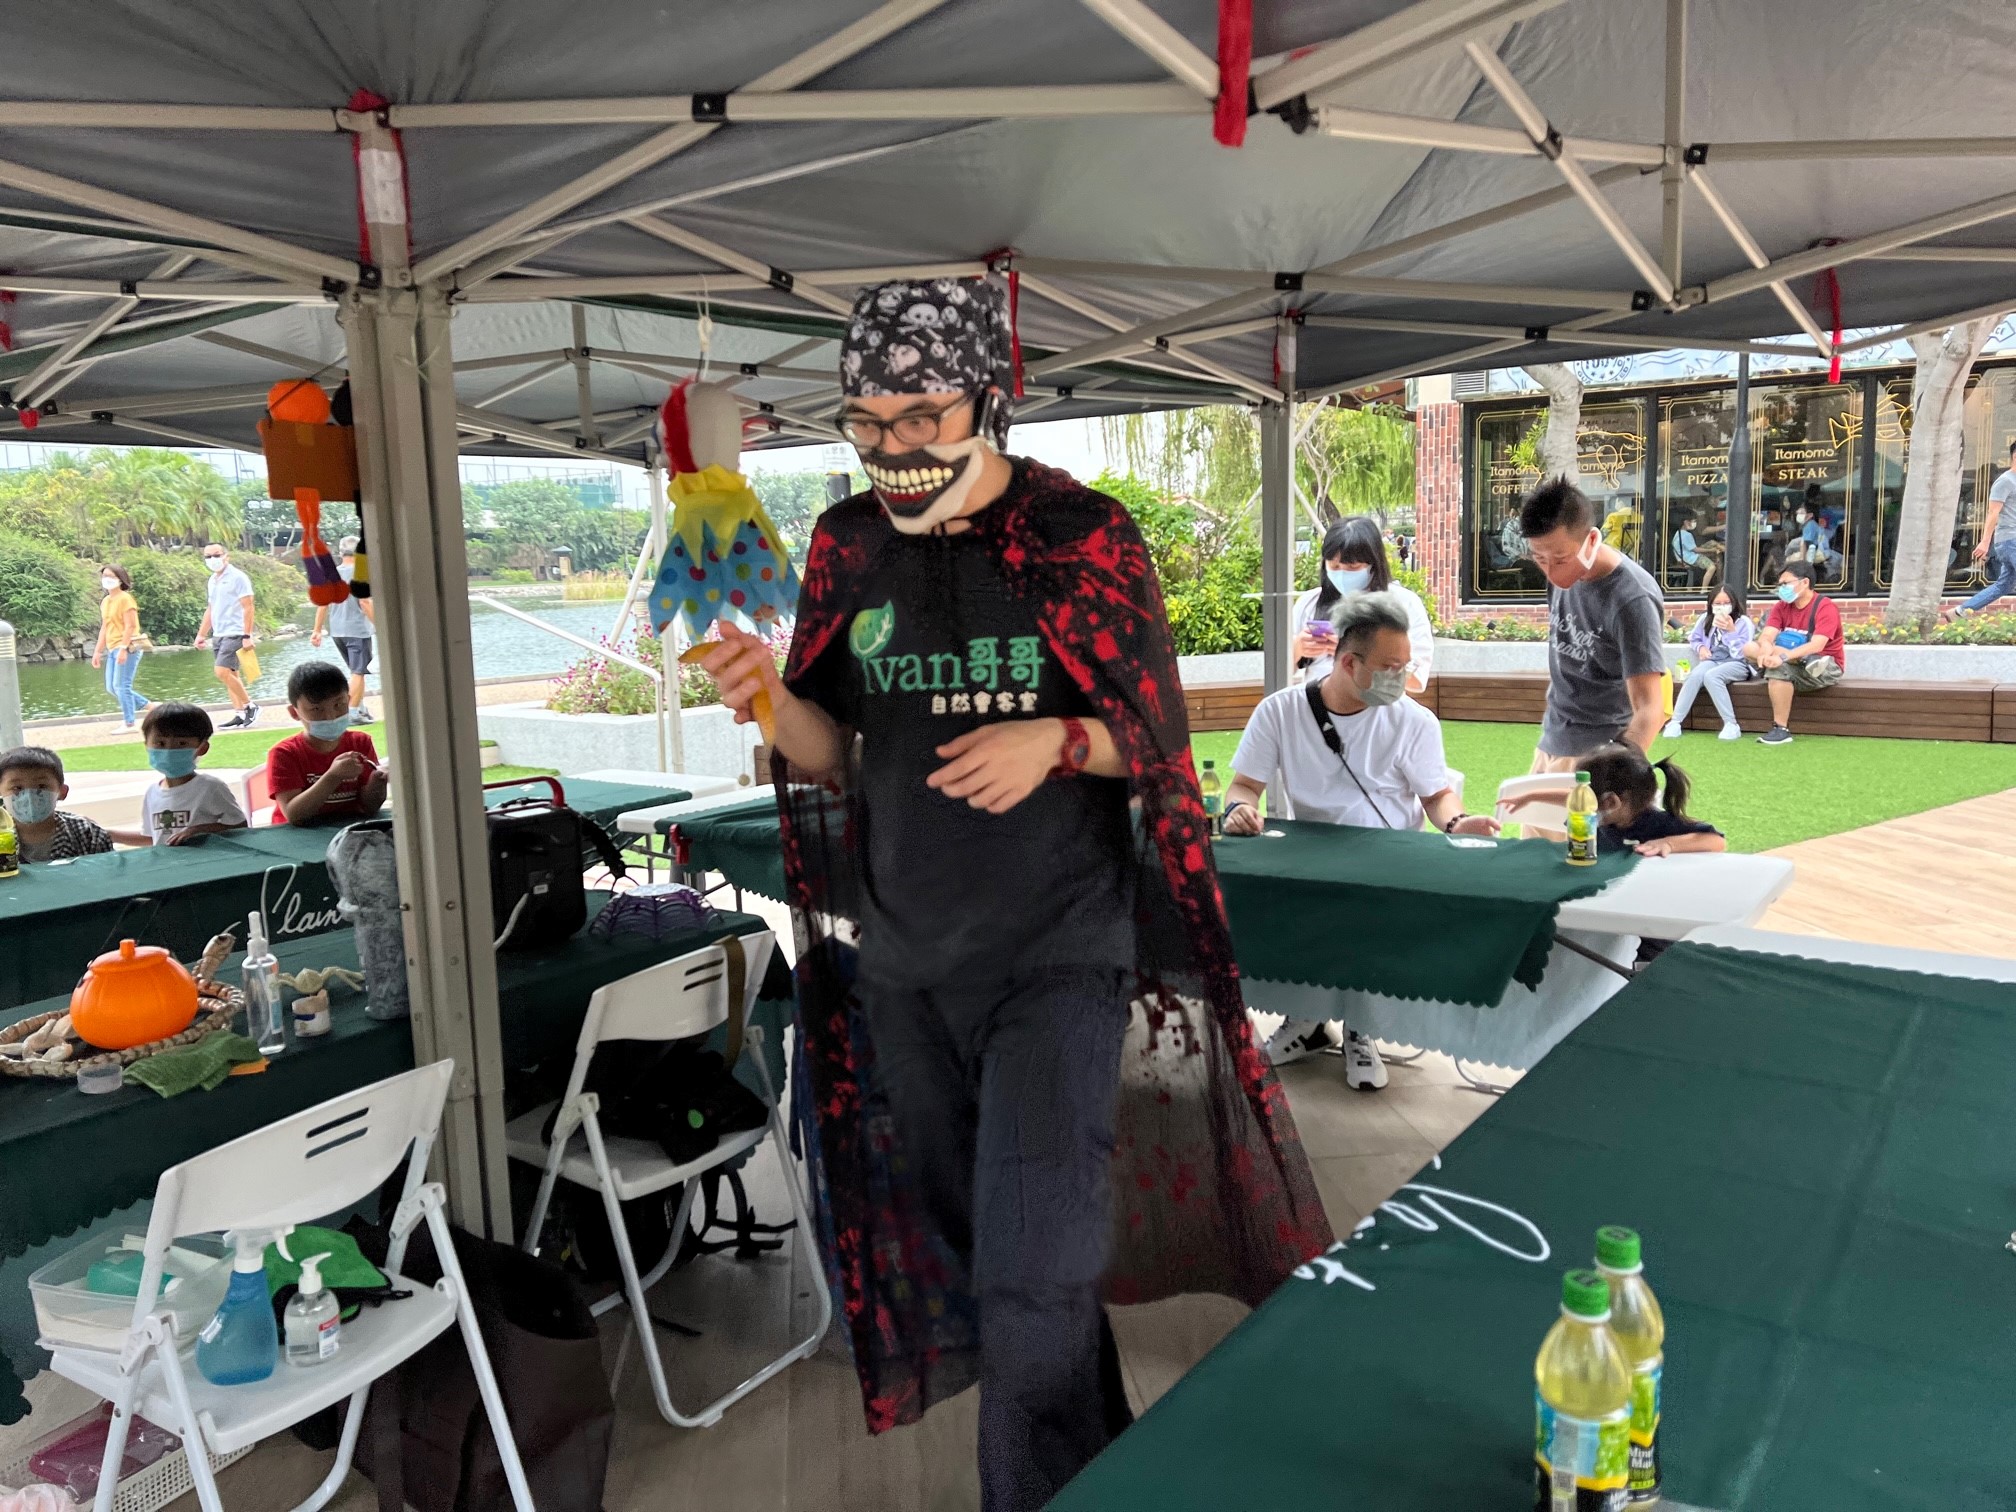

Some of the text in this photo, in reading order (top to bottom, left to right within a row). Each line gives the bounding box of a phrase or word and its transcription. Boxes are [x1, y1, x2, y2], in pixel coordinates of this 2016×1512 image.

[1681, 454, 1729, 467] Itamom
[1775, 448, 1835, 460] Itamomo
[1778, 466, 1828, 480] STEAK
